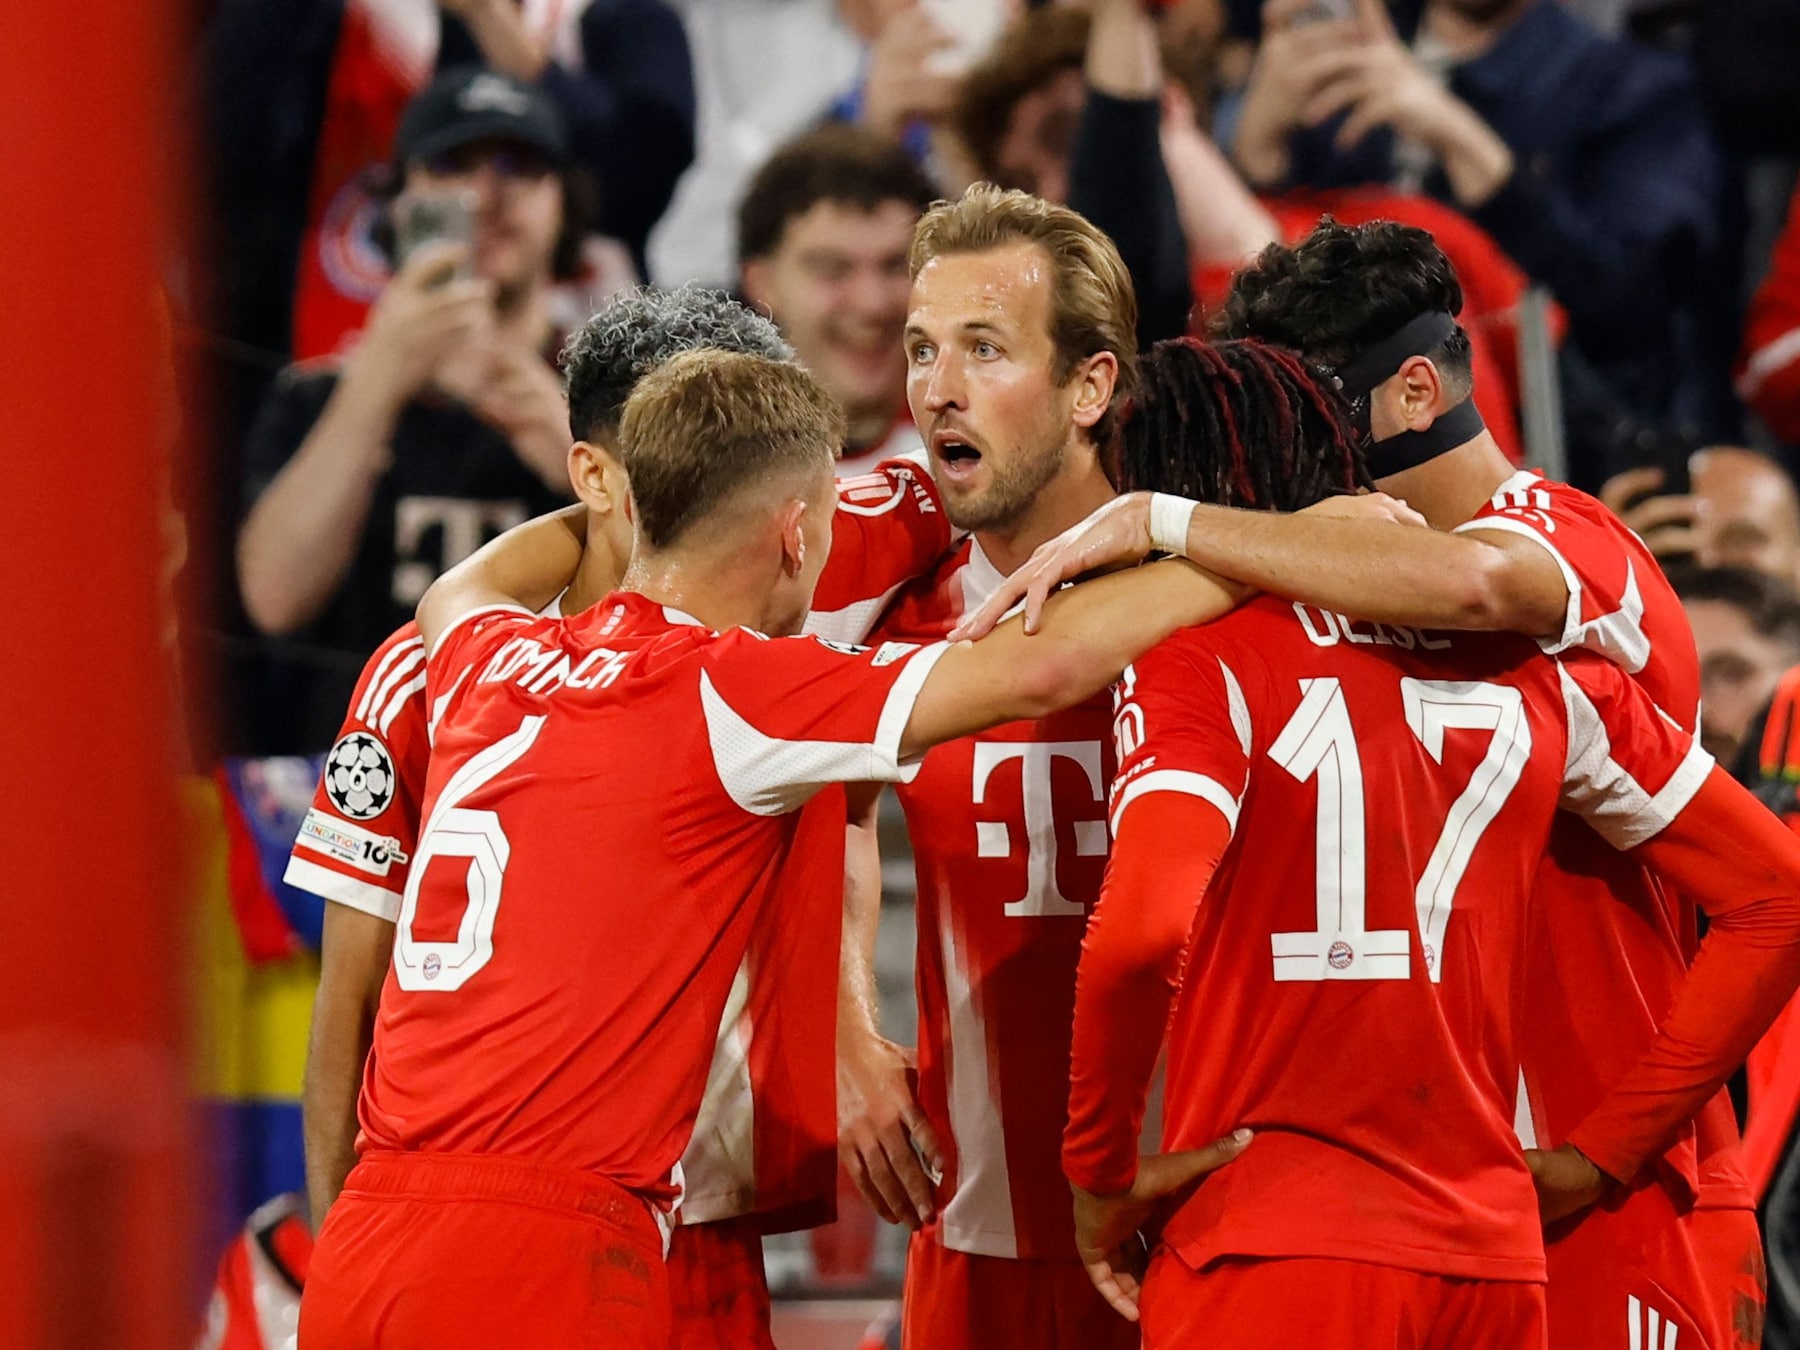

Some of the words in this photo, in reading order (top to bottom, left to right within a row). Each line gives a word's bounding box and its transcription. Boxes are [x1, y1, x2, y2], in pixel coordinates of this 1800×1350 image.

[348, 760, 367, 792] 6
[393, 714, 548, 991] 6
[1267, 676, 1532, 983] 17
